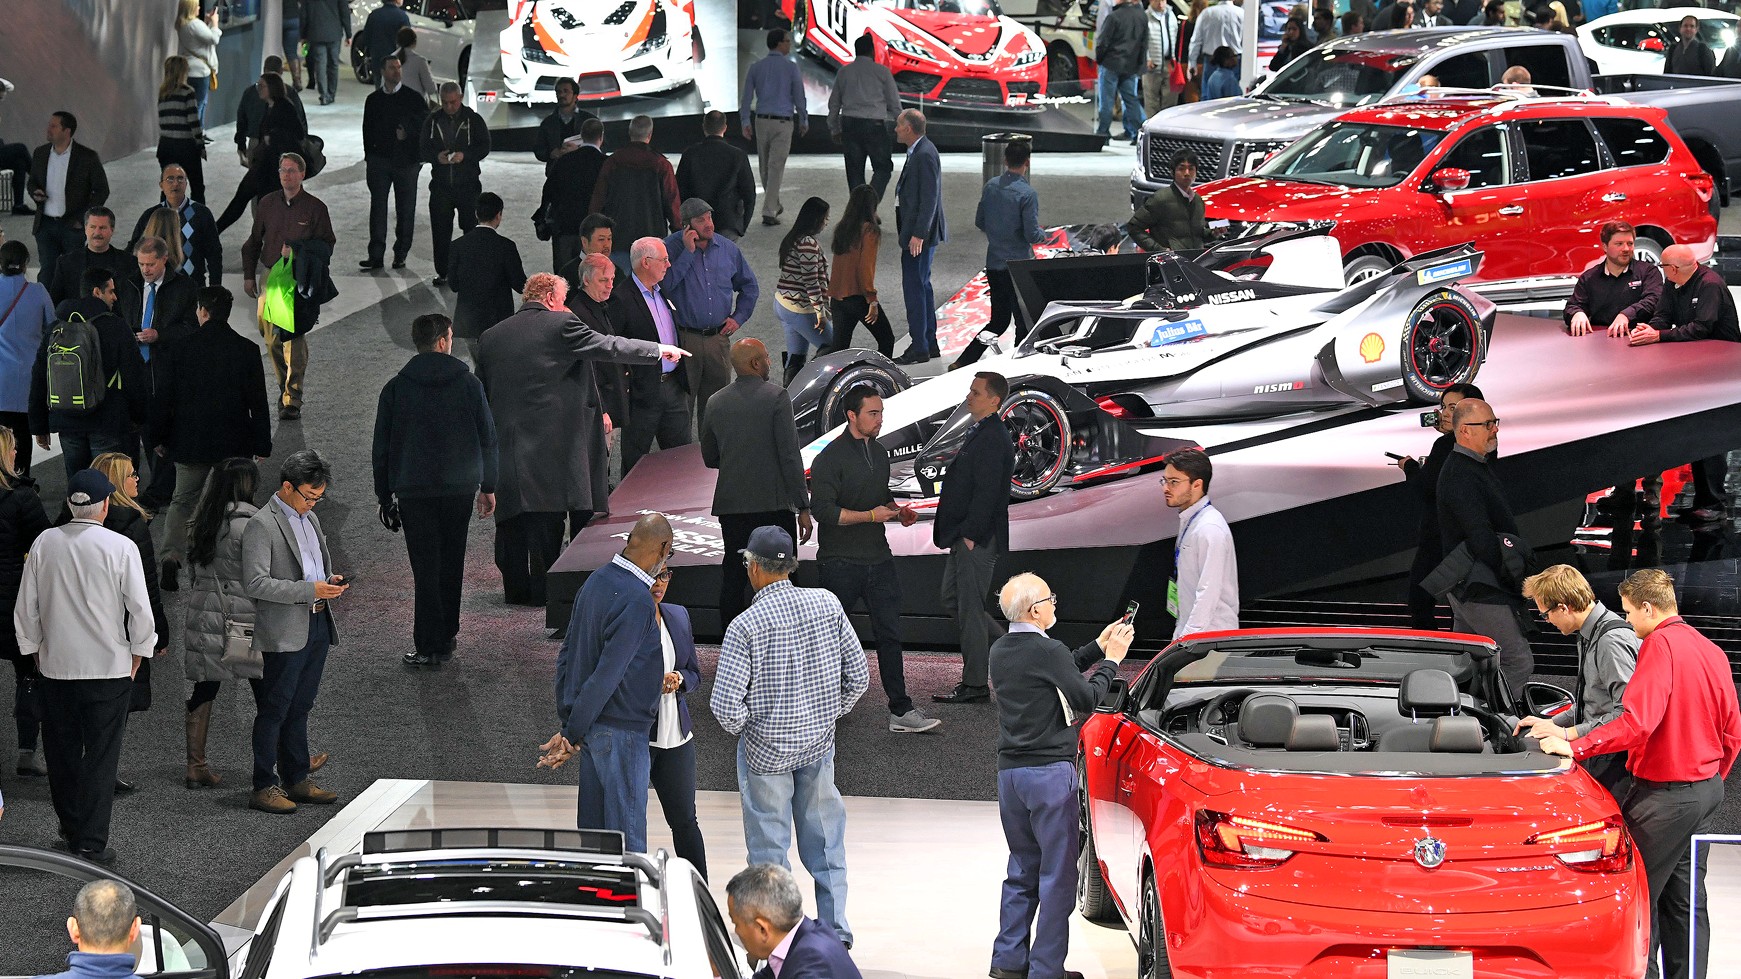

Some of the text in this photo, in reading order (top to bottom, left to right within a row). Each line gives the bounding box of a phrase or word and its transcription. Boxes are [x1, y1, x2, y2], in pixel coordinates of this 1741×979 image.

[1027, 93, 1092, 109] Supra
[1207, 288, 1256, 305] NISSAN
[1453, 294, 1477, 317] MICHELIN
[1156, 326, 1186, 339] Julius
[1410, 376, 1435, 397] MICHELIN
[1400, 967, 1461, 976] BUICK
